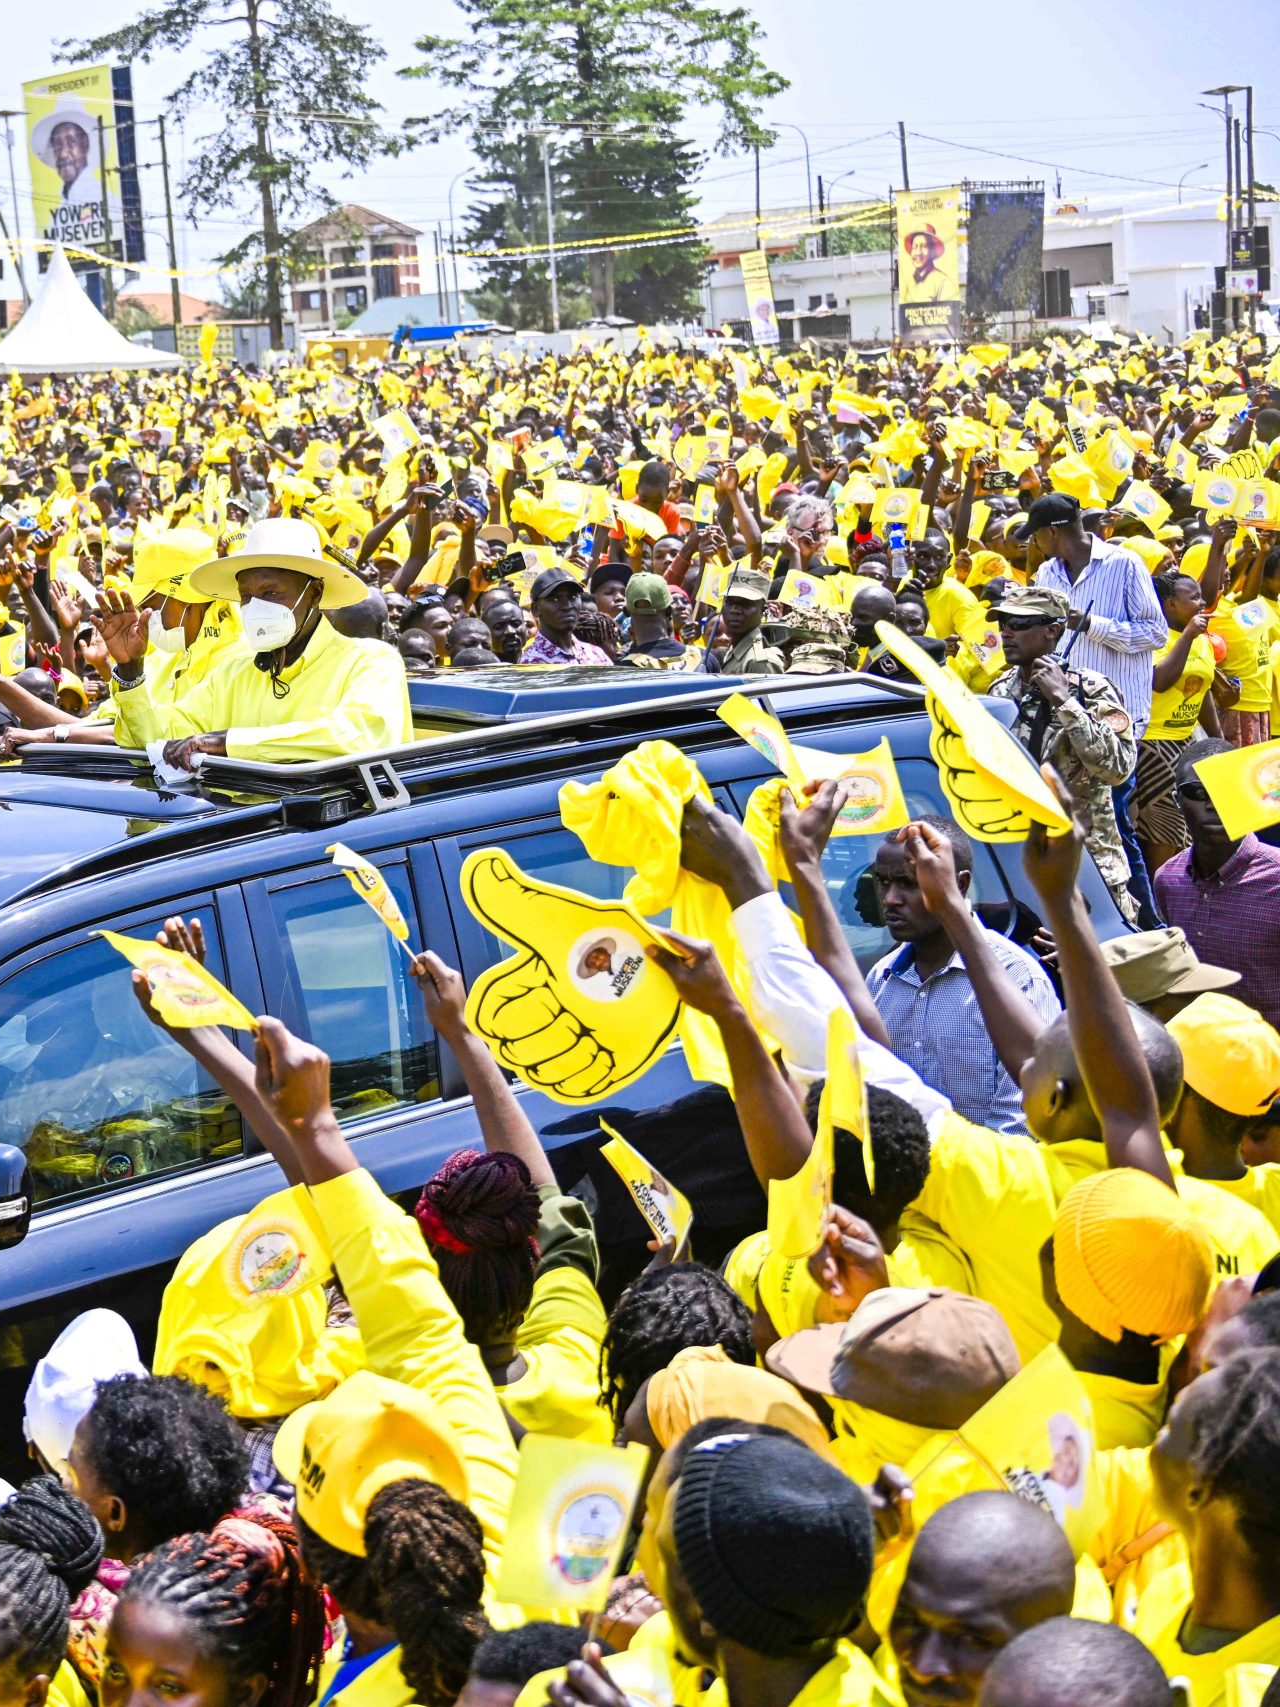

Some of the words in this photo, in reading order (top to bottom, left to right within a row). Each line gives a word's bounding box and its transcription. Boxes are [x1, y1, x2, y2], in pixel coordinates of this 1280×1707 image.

[48, 77, 90, 95] PRESIDENT
[614, 955, 644, 998] MUSEVENI
[630, 1180, 668, 1235] MUSEVENI
[639, 1179, 666, 1223] YOWERI
